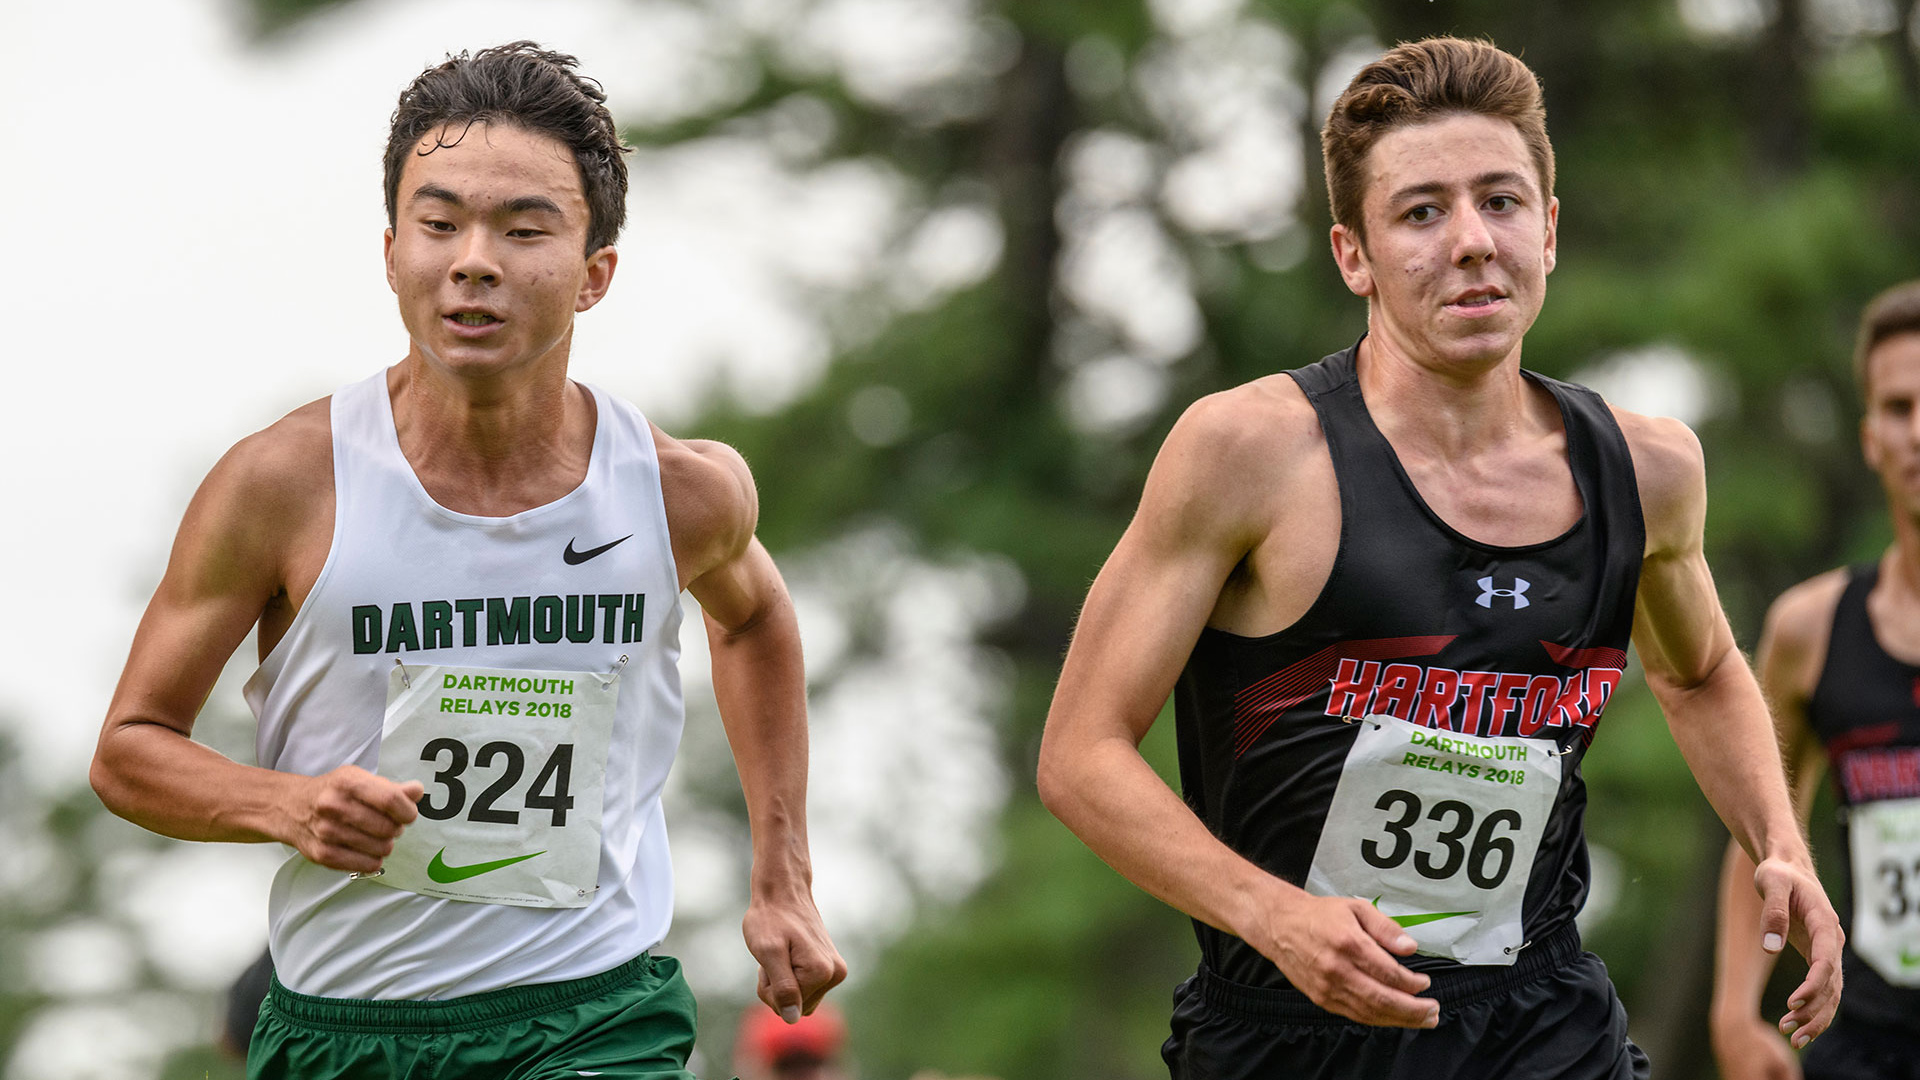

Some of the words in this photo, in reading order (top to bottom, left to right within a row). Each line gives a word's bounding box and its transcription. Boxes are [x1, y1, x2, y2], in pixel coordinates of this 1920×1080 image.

[352, 593, 645, 654] DARTMOUTH
[443, 674, 574, 695] DARTMOUTH
[1324, 658, 1623, 737] HARTFORD
[440, 698, 520, 716] RELAYS
[525, 702, 573, 719] 2018
[1402, 752, 1481, 779] RELAYS
[1484, 767, 1525, 786] 2018
[1410, 731, 1528, 762] DARTMOUTH
[417, 737, 575, 828] 324
[1361, 789, 1522, 890] 336
